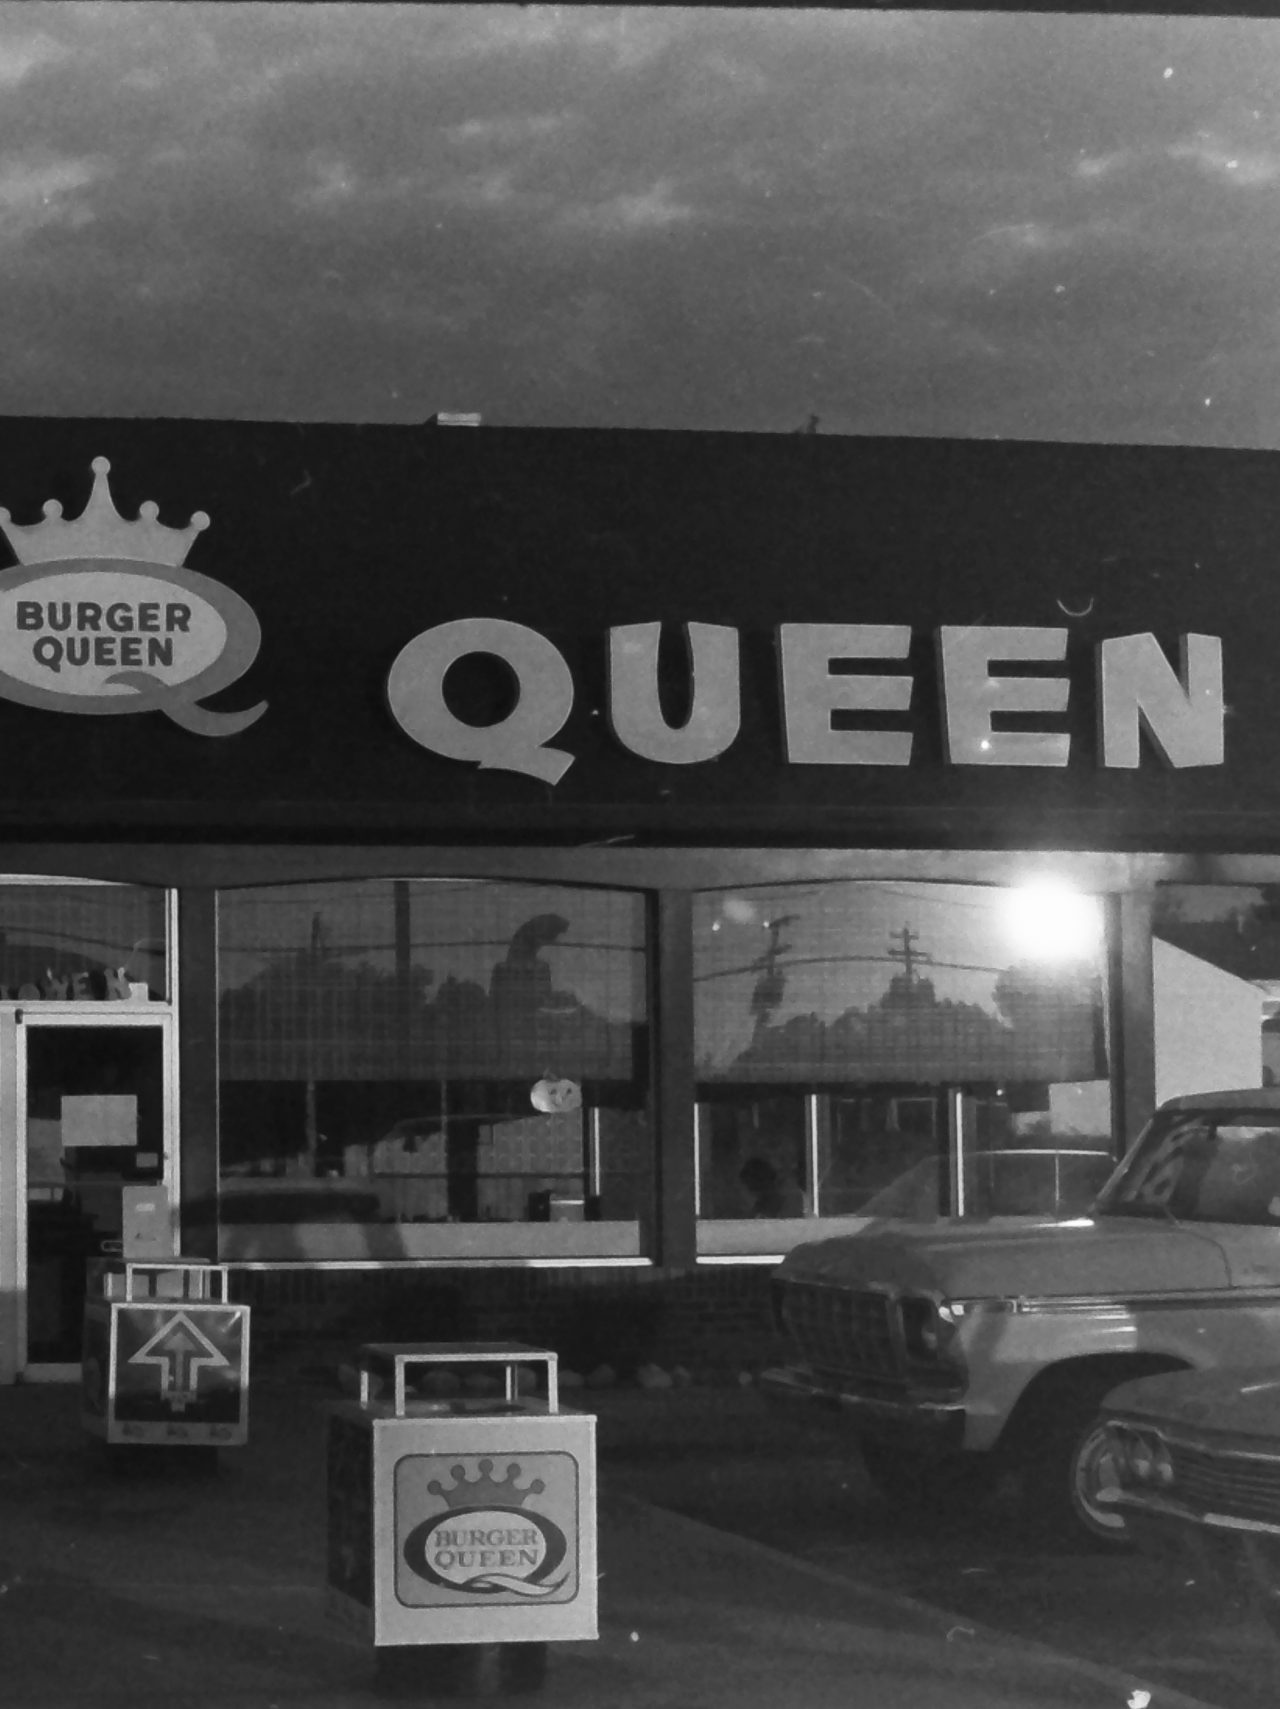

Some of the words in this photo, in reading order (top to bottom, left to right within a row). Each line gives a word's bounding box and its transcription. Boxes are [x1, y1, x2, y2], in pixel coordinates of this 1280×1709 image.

[16, 601, 192, 633] BURGER
[32, 636, 174, 673] QUEEN
[387, 616, 1225, 786] QUEEN
[434, 1527, 538, 1548] BURGER
[434, 1548, 538, 1570] QUEEN
